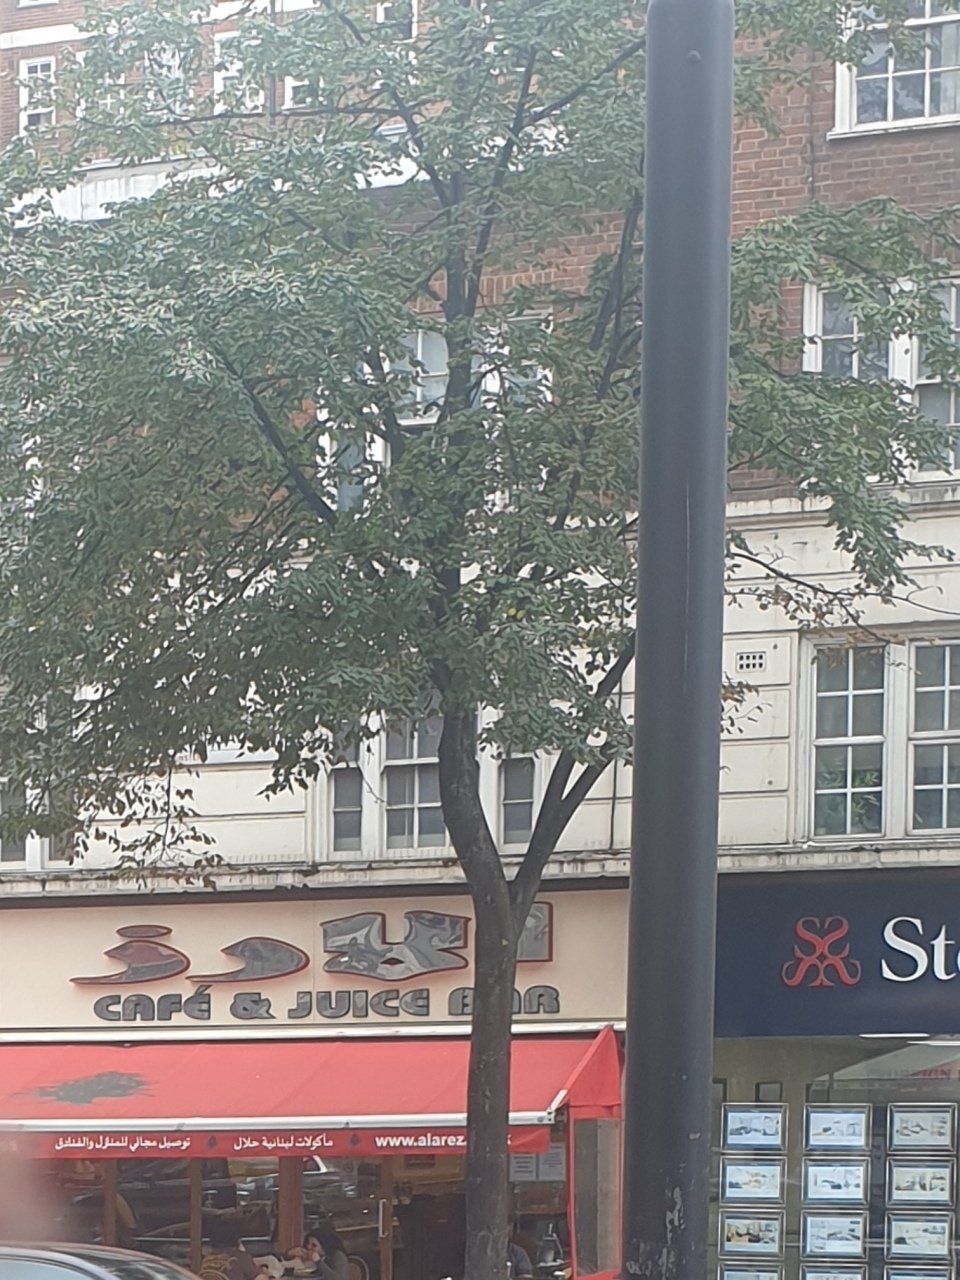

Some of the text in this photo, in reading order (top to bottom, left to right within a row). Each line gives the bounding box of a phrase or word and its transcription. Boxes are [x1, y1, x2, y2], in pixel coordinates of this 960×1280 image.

[881, 916, 960, 983] St
[93, 985, 559, 1021] CAFÉ & JUICE BR
